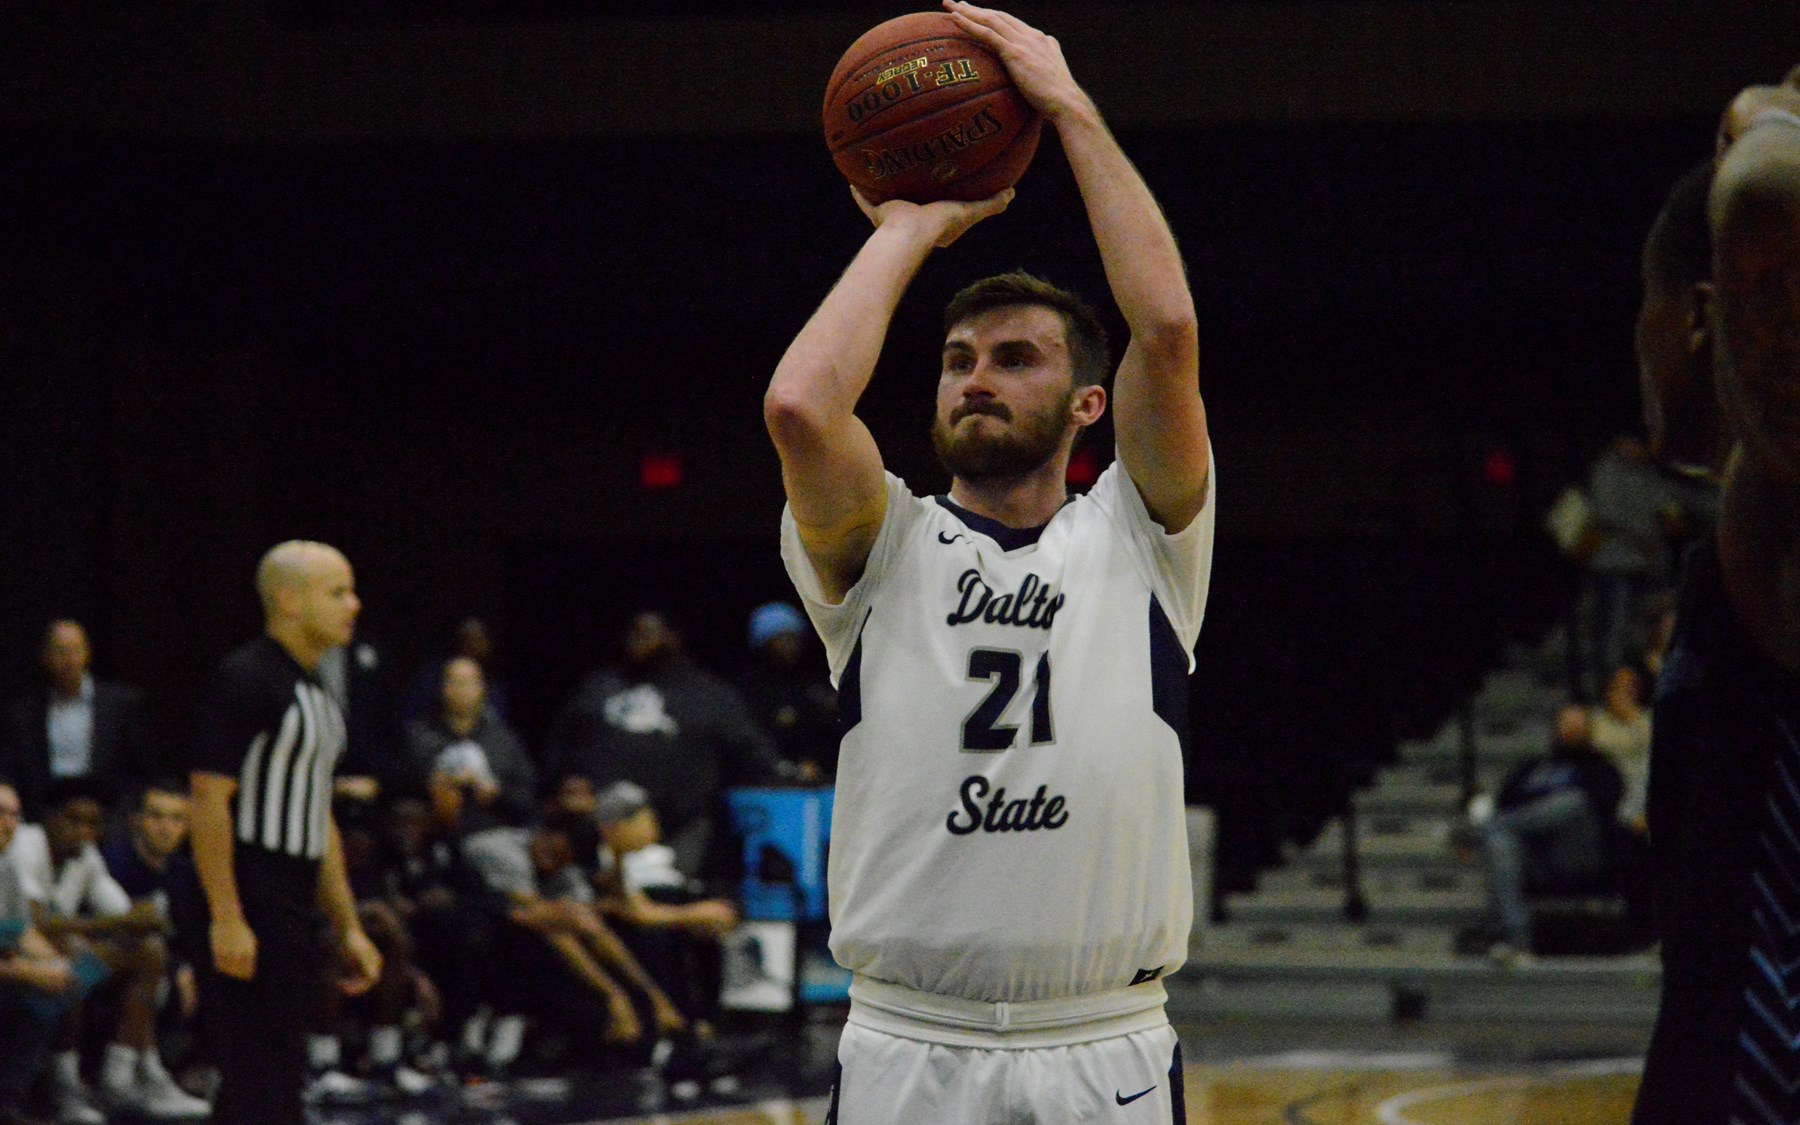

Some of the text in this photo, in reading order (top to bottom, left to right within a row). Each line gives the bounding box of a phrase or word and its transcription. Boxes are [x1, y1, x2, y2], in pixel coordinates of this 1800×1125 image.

[861, 104, 1002, 181] SPALDING
[960, 647, 1056, 753] 21
[946, 775, 1069, 835] State
